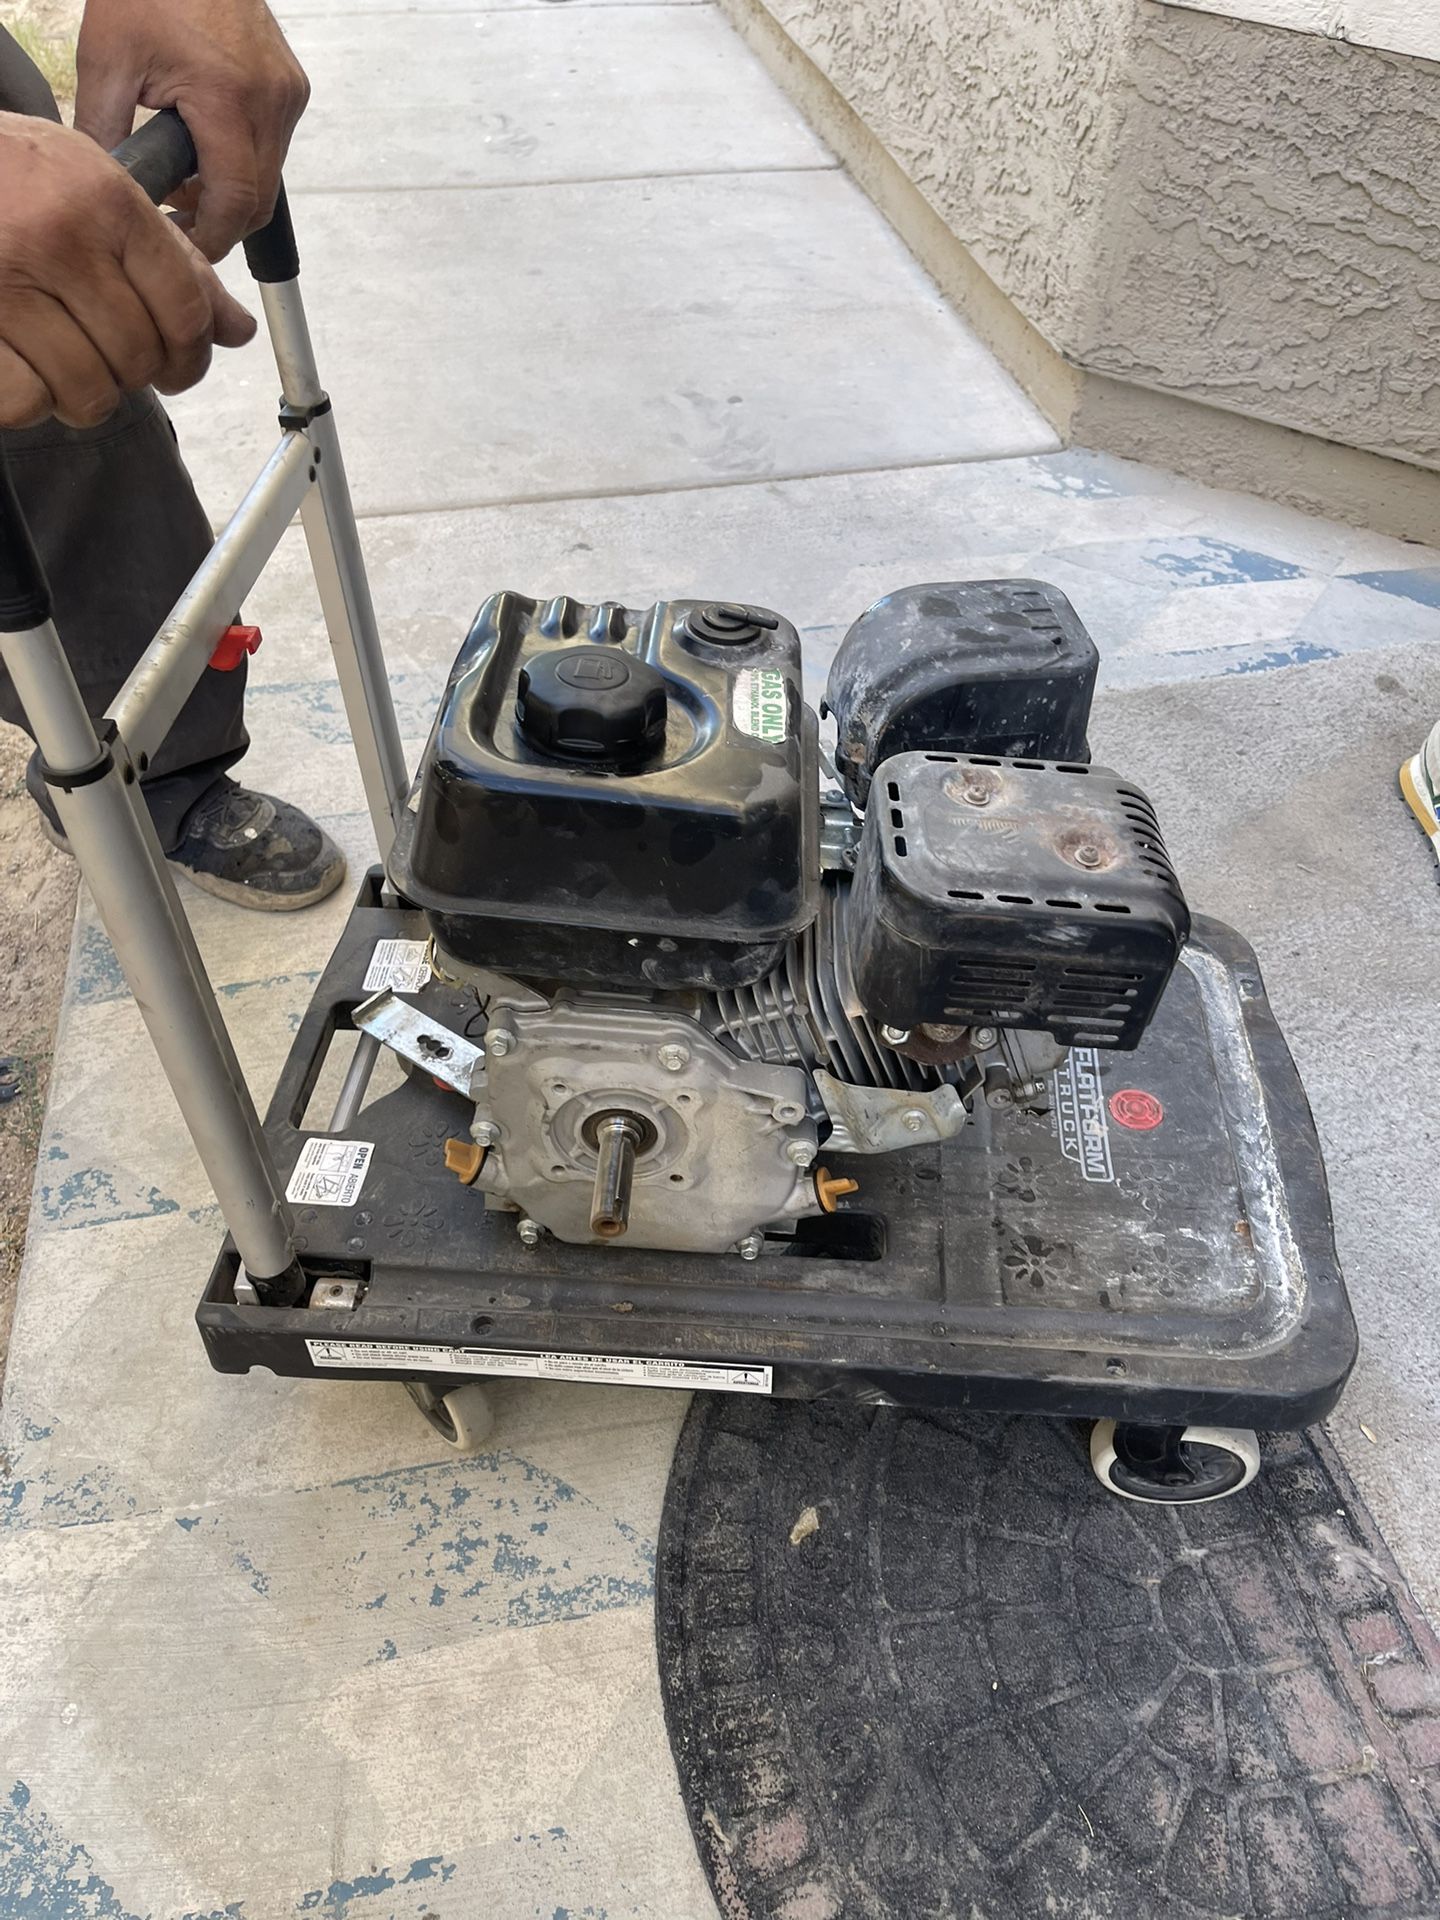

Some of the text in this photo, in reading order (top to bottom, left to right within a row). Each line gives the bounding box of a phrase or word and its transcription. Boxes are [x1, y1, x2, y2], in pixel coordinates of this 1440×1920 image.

[751, 711, 760, 731] BLEND
[761, 668, 784, 742] GAS ONLY
[1059, 1068, 1078, 1151] TRUCK
[1075, 1047, 1106, 1173] FLATFORM
[352, 1147, 369, 1170] OPEN
